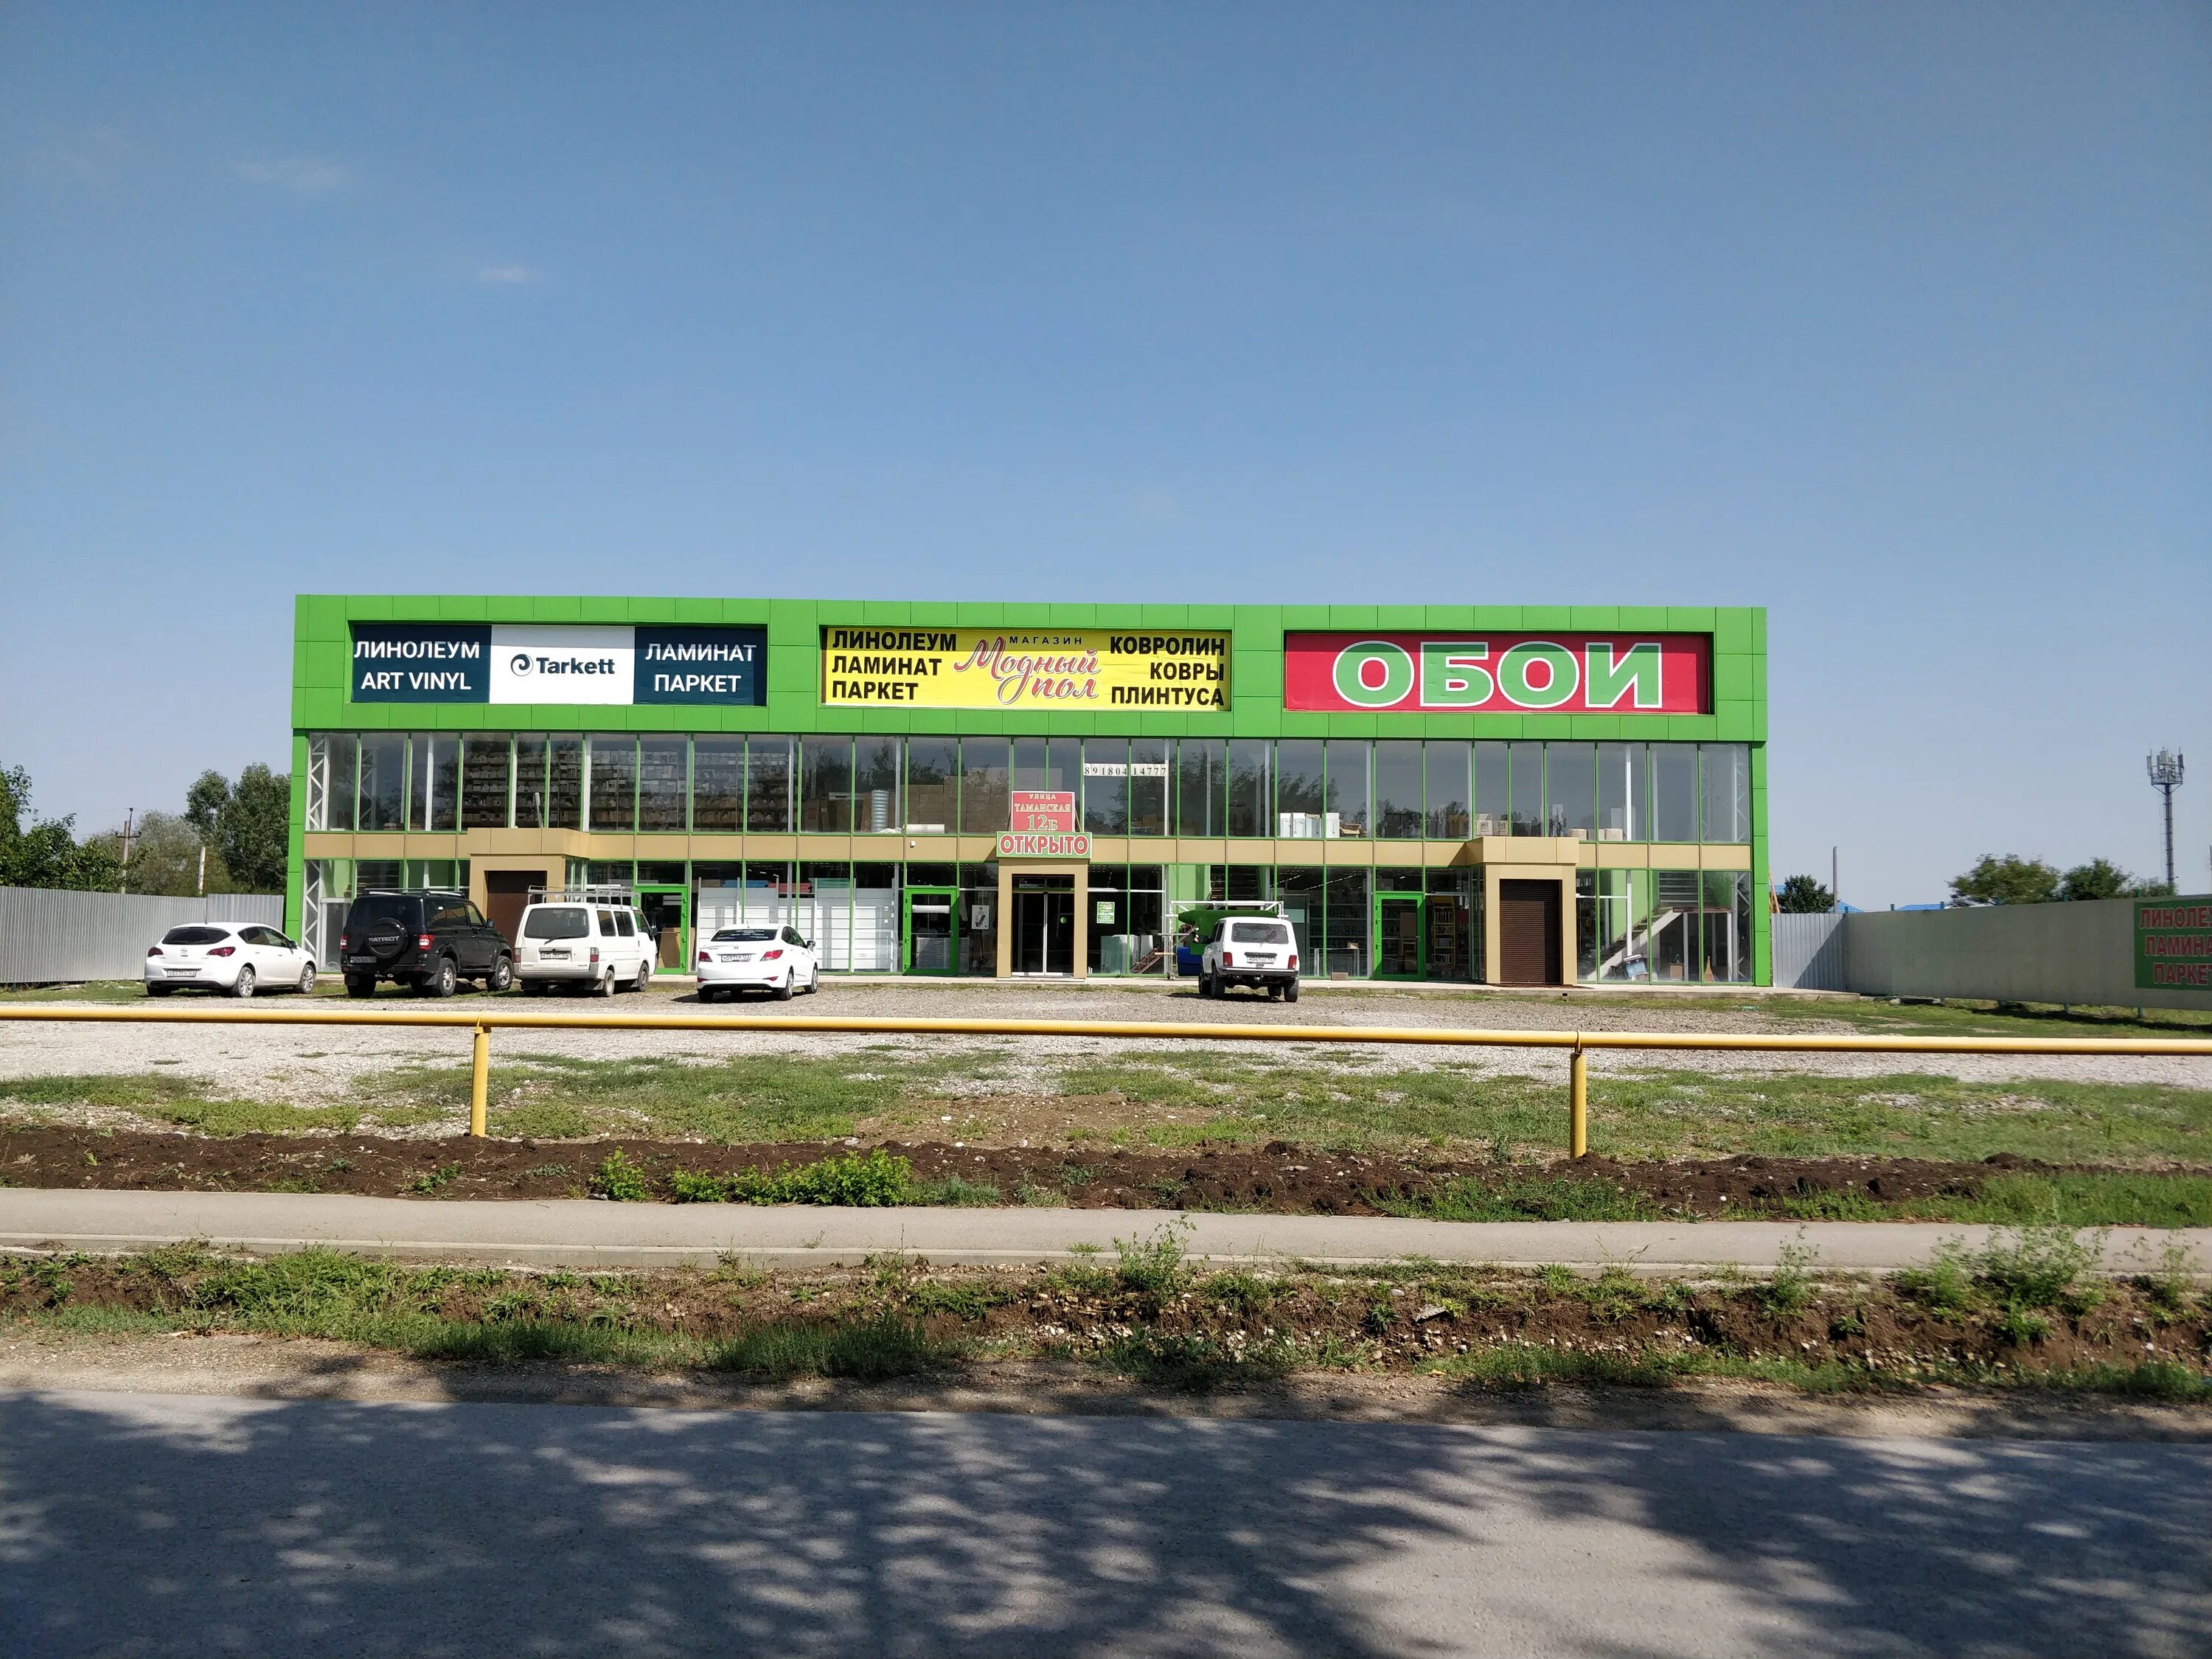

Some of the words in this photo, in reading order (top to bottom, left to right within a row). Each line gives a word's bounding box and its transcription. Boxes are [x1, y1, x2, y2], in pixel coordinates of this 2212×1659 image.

[354, 641, 479, 659] ЛИНОЛЕУМ
[832, 630, 956, 651] ЛИНОЛЕУМ
[1009, 636, 1082, 645] МАГАЗИН
[1110, 636, 1225, 656] КОВРОЛИН
[645, 643, 757, 662] ЛАМИНАТ
[536, 657, 615, 675] Tarkett
[832, 655, 942, 676] ЛАМИНАТ
[953, 636, 1102, 705] Модный
[1150, 662, 1224, 681] КОВРЫ
[1332, 640, 1663, 709] ОБОИ
[361, 672, 404, 690] ART
[408, 672, 472, 690] VINYL
[654, 674, 742, 693] ПАРКЕТ
[832, 681, 919, 700] ПАРКЕТ
[1032, 677, 1099, 699] пол
[1111, 686, 1225, 706] ПЛИНТУСА
[1014, 804, 1071, 813] ТАМАНСКАЯ
[1026, 814, 1059, 831] 12Б
[999, 834, 1089, 856] ОТКРЫТО
